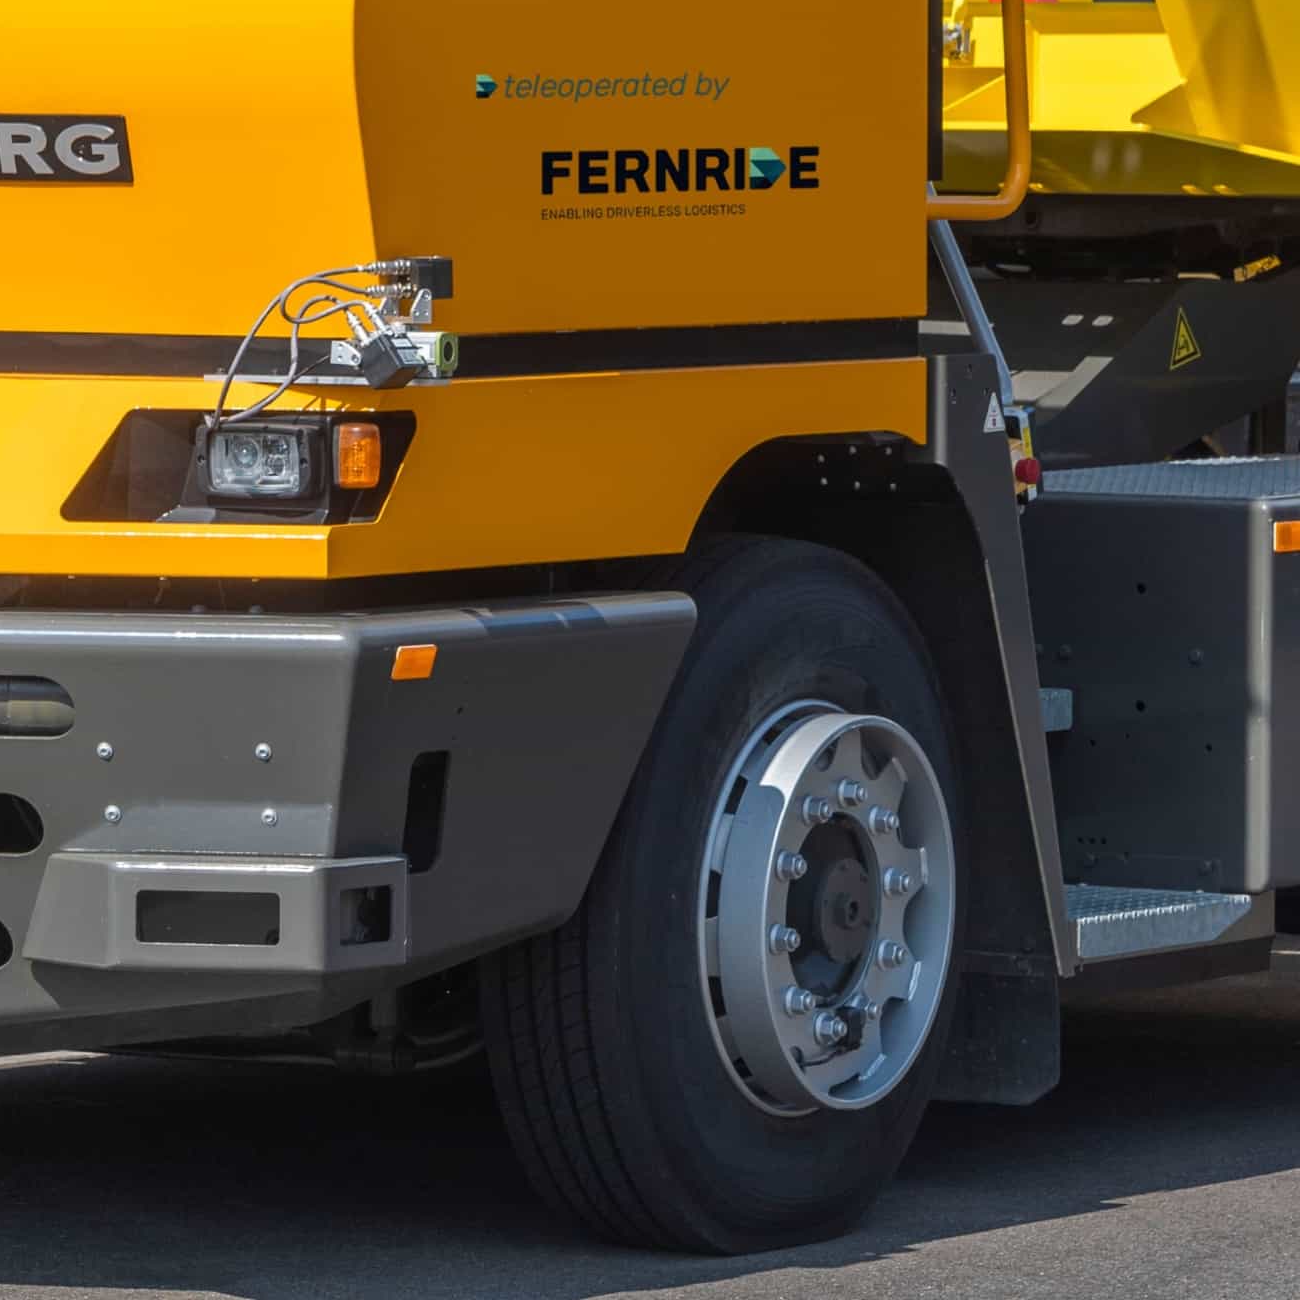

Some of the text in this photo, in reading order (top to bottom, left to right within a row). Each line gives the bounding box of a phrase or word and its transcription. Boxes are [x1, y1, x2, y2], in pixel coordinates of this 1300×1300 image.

[504, 71, 731, 102] teleoperated by
[541, 146, 820, 196] FERNRIDE
[540, 203, 746, 221] ENABLING DRIVERLESS LOGISTICS
